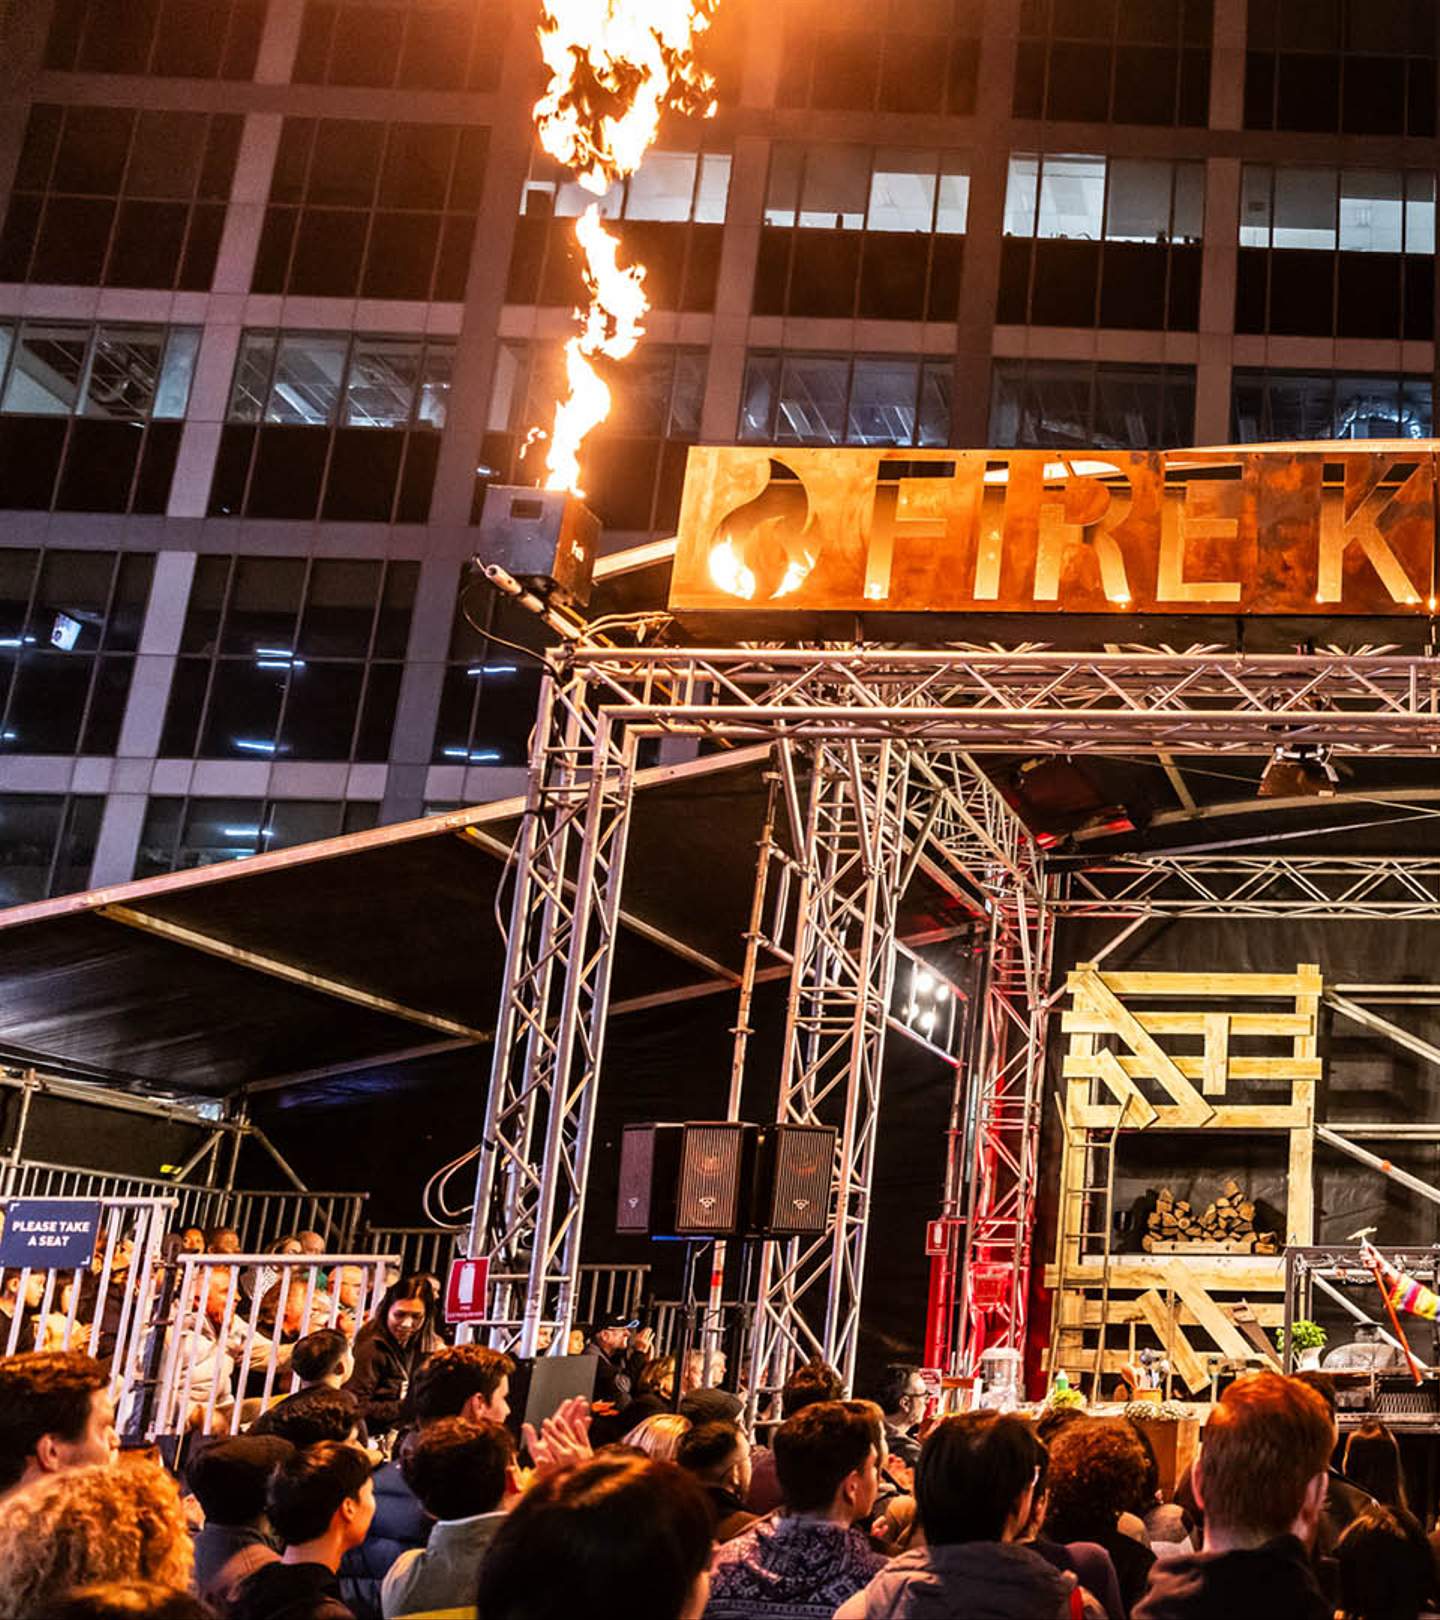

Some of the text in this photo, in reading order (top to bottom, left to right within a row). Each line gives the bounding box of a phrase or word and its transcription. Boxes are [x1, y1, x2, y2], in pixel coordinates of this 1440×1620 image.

[863, 459, 1243, 603] FIRE
[12, 1221, 90, 1232] PLEASE TAKE
[28, 1235, 70, 1246] A SEAT
